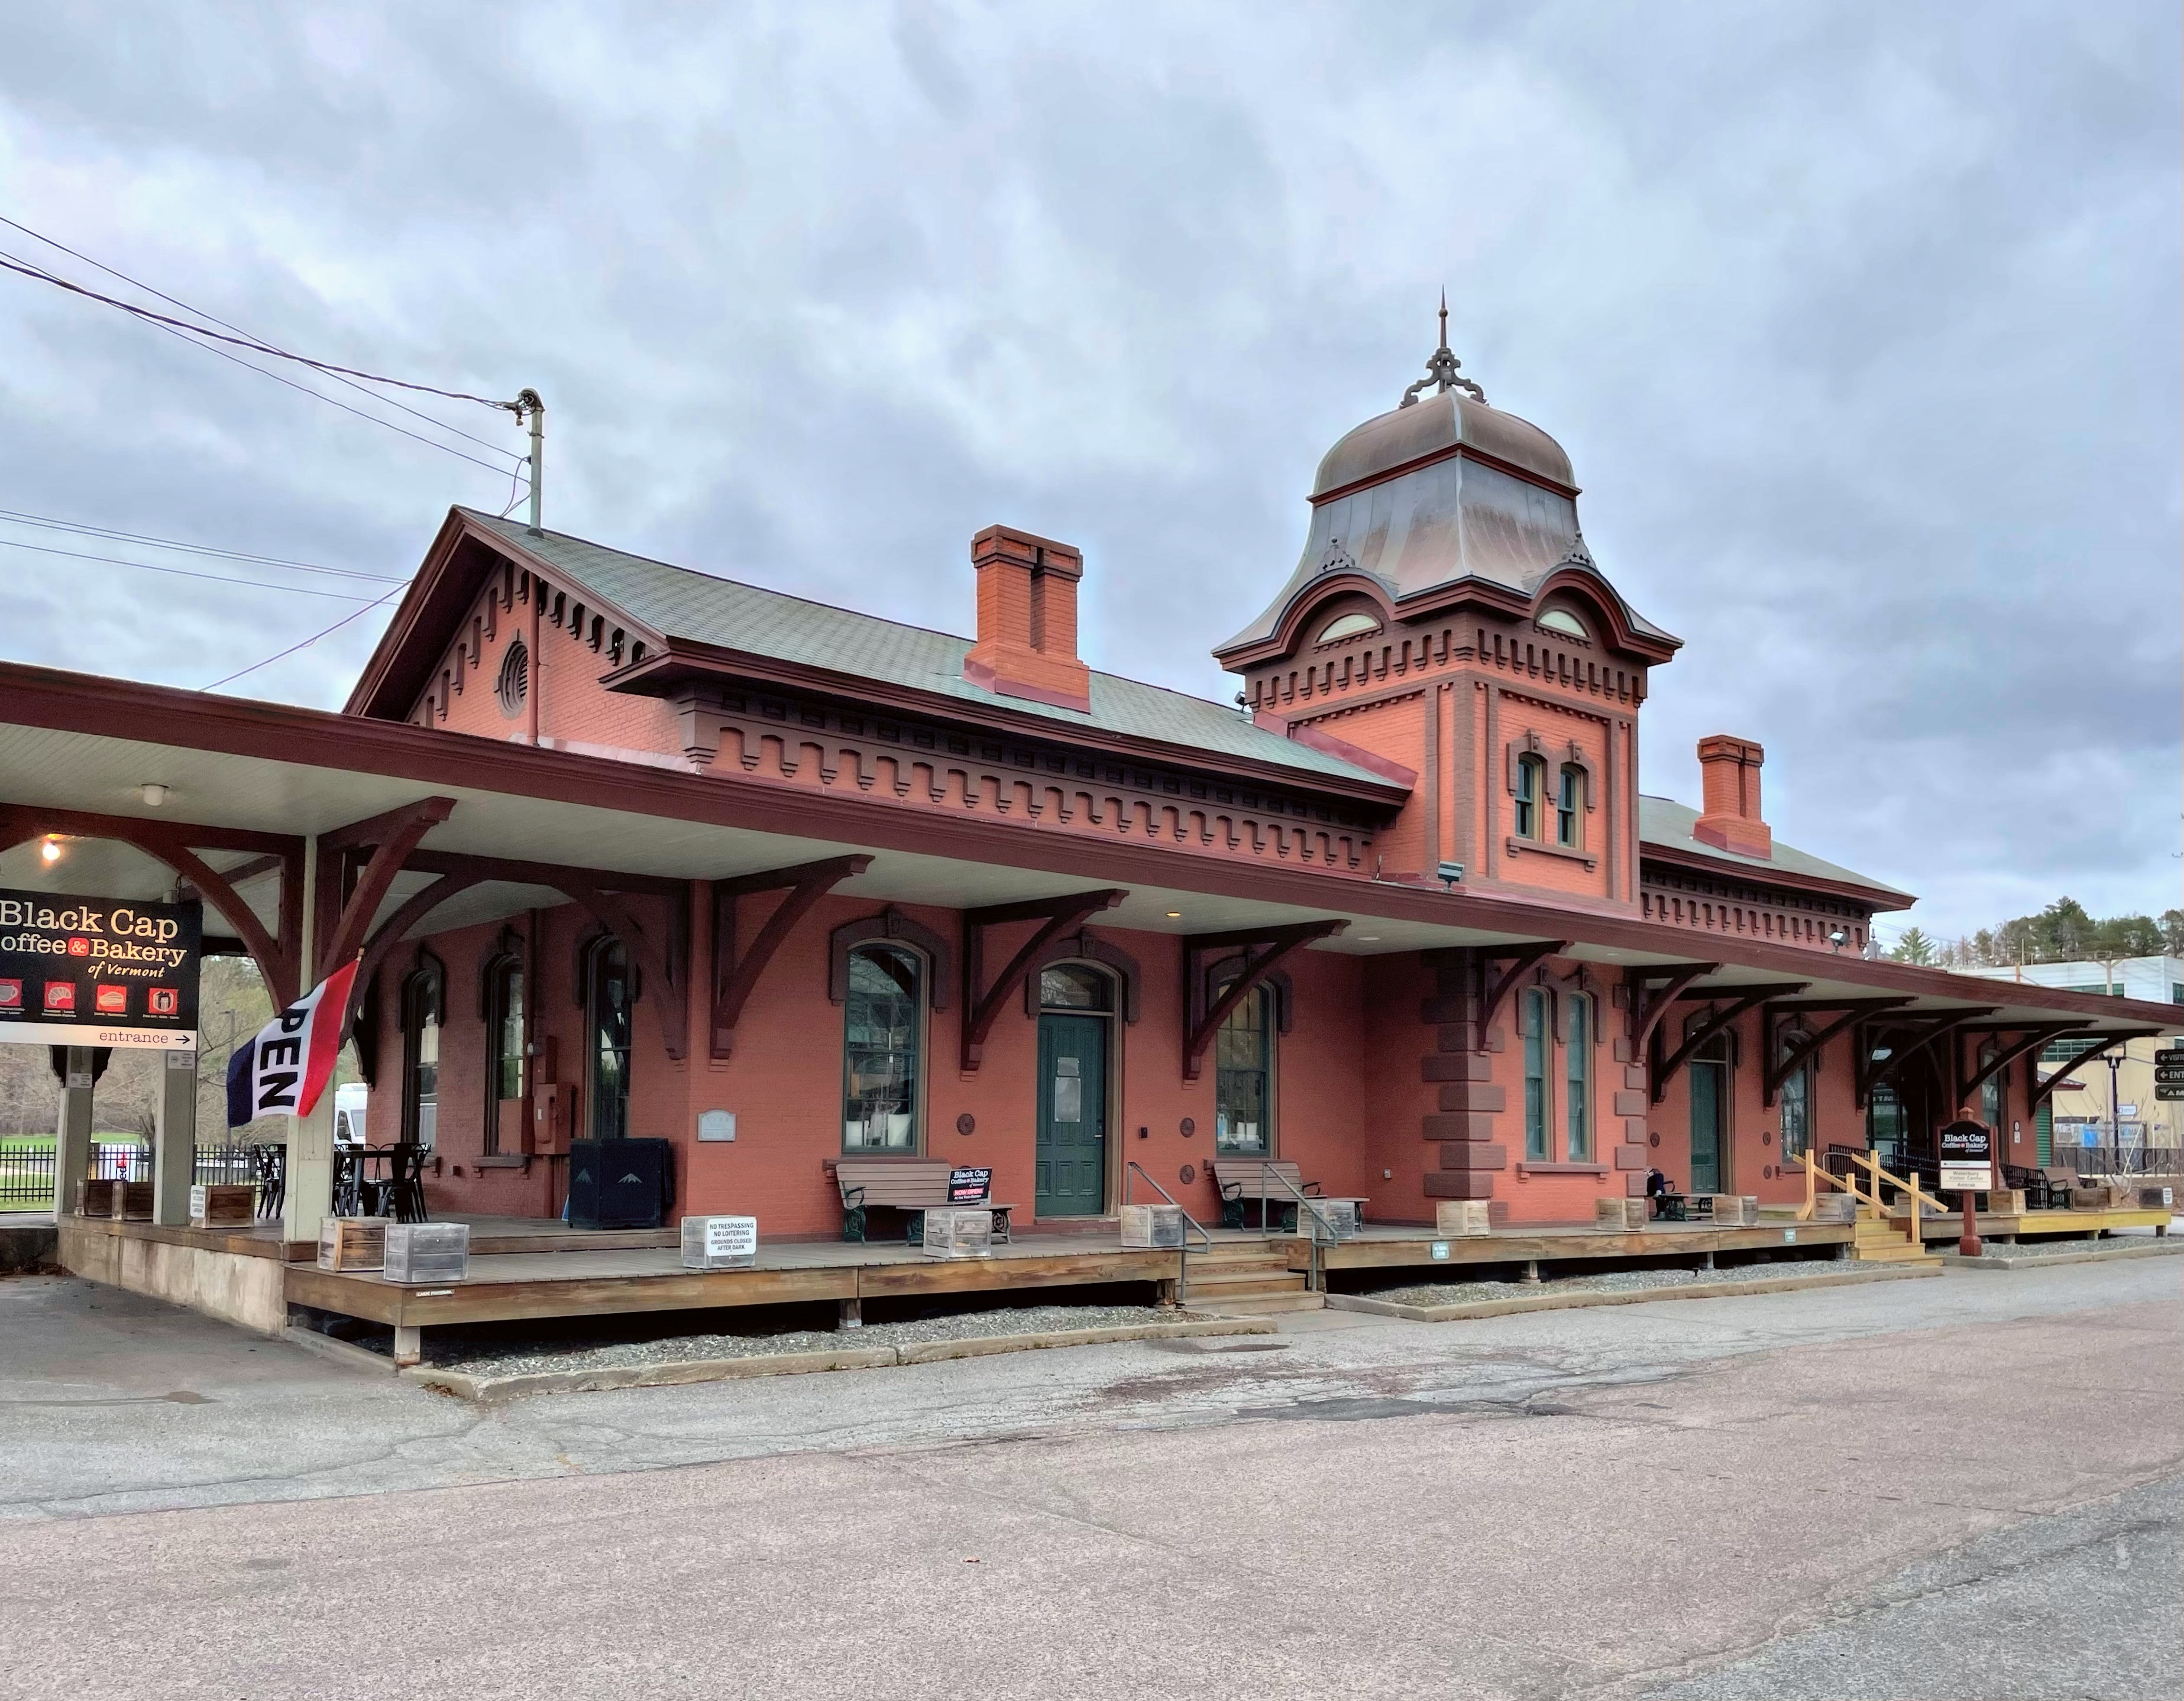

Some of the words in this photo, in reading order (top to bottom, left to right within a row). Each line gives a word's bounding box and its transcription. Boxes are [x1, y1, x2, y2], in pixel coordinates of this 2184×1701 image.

[0, 900, 104, 932] Black
[111, 909, 178, 944] Cap
[1, 933, 67, 954] offee
[71, 940, 88, 954] &
[90, 938, 187, 967] Bakery
[88, 960, 106, 979] of
[107, 963, 166, 978] Vermont
[99, 1031, 169, 1044] entrance
[258, 1007, 310, 1110] PEN
[1969, 1134, 1986, 1143] Cap
